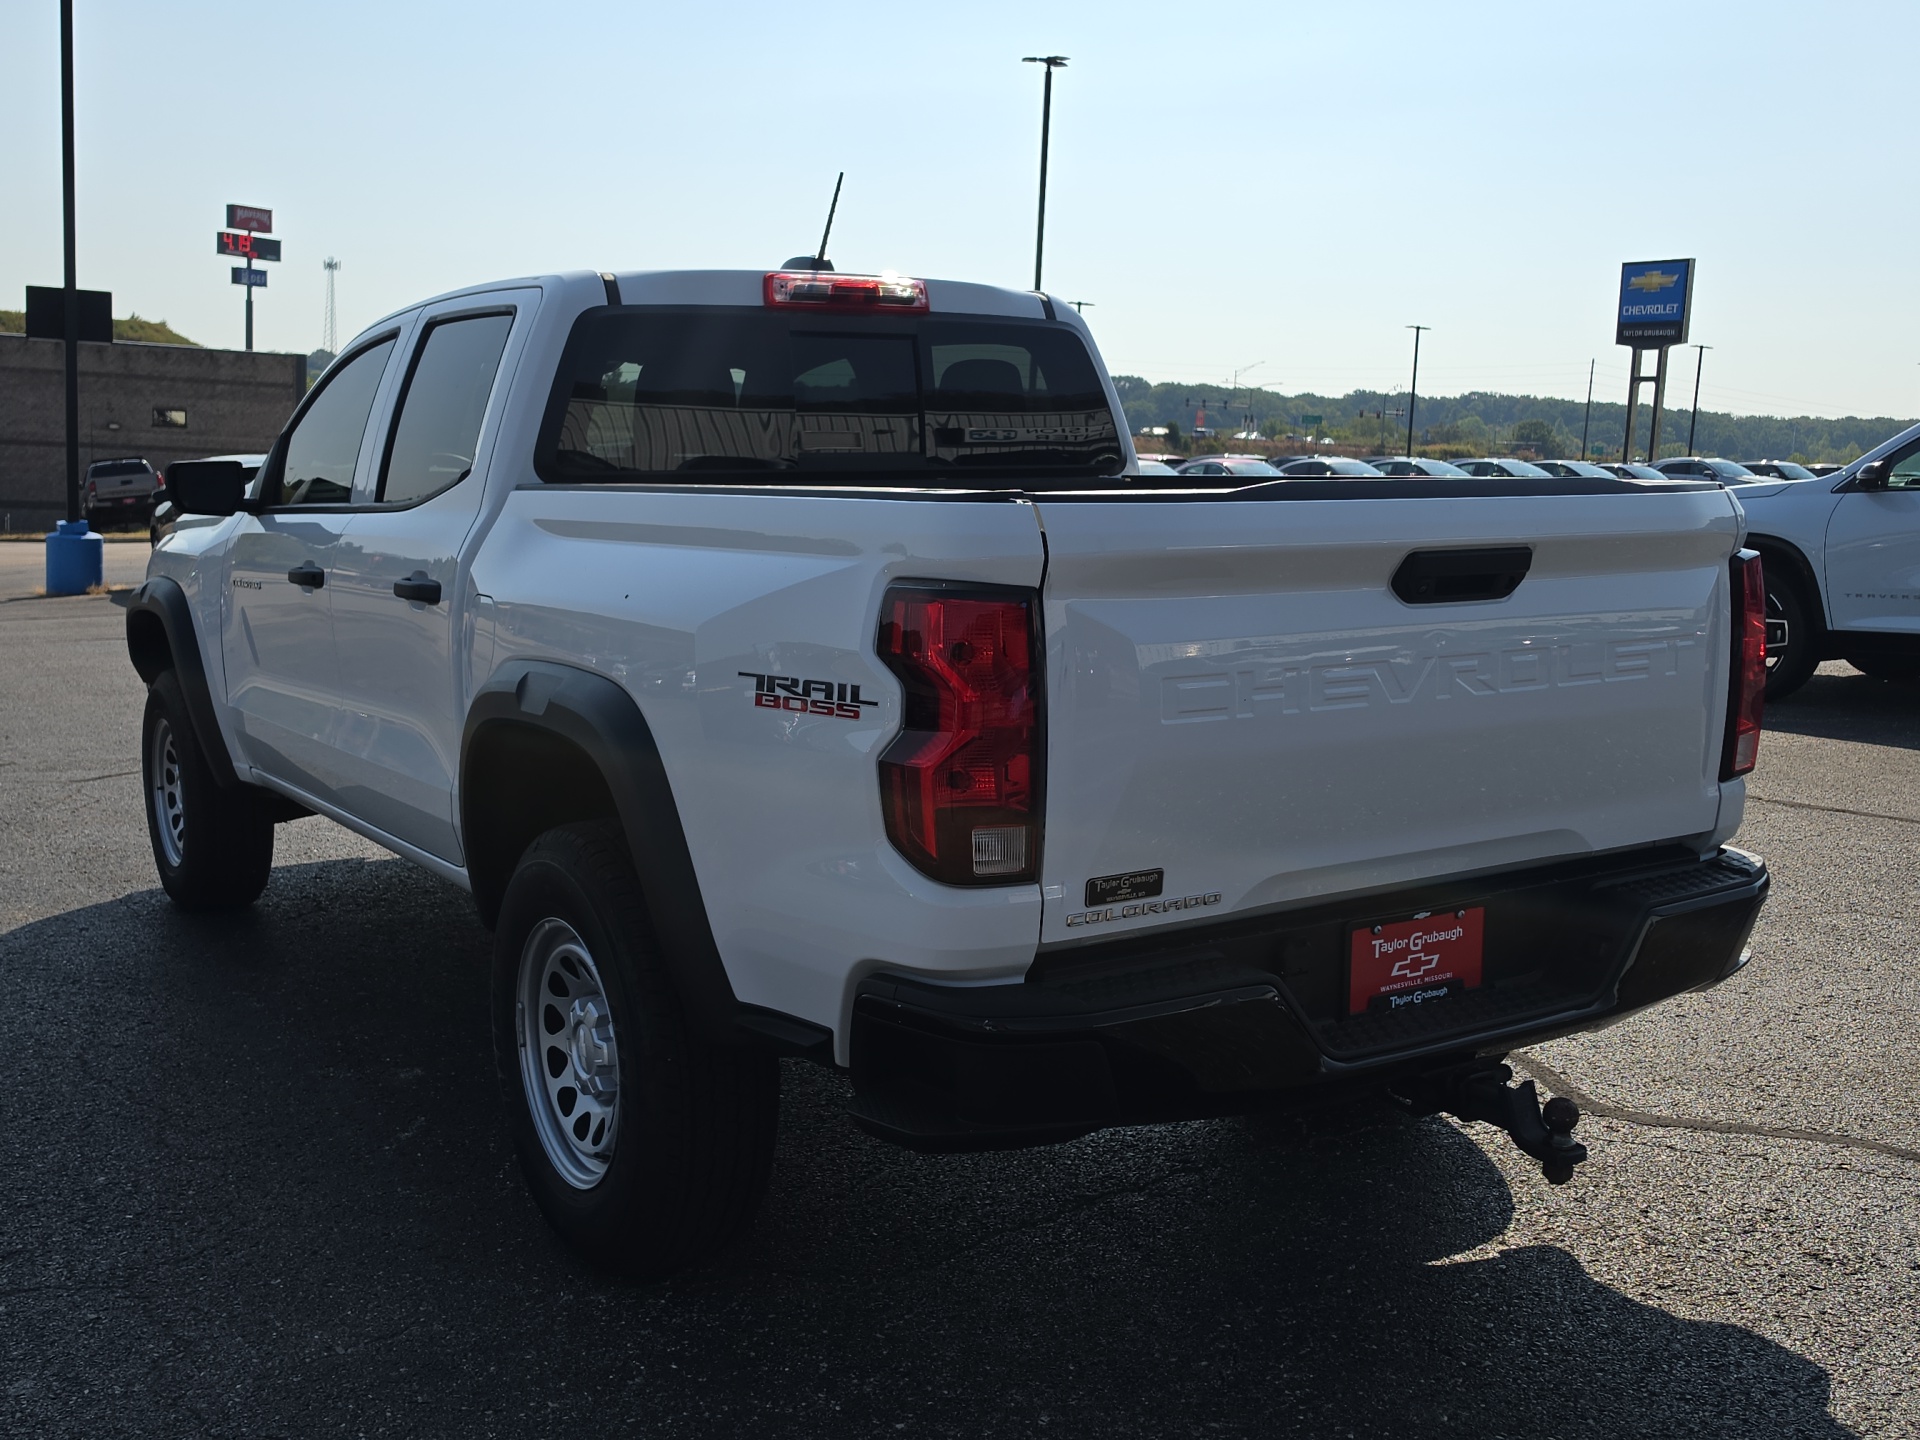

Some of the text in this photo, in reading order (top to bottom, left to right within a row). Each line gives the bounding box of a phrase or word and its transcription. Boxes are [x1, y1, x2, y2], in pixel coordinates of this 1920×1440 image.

[1623, 304, 1678, 315] CHEVROLET
[1644, 329, 1675, 337] GRUBAUGH
[738, 671, 879, 707] TRAIL
[1160, 634, 1695, 725] CHEVROLET
[754, 692, 861, 721] BOSS
[1094, 873, 1159, 892] Taylor Grubaugh
[1066, 892, 1222, 927] COLORADO
[1372, 926, 1463, 958] Taylor Grubaugh
[1380, 972, 1453, 992] WAYNESVILLE, MISSOURI
[1390, 987, 1448, 1008] Taylor Grubaugh
